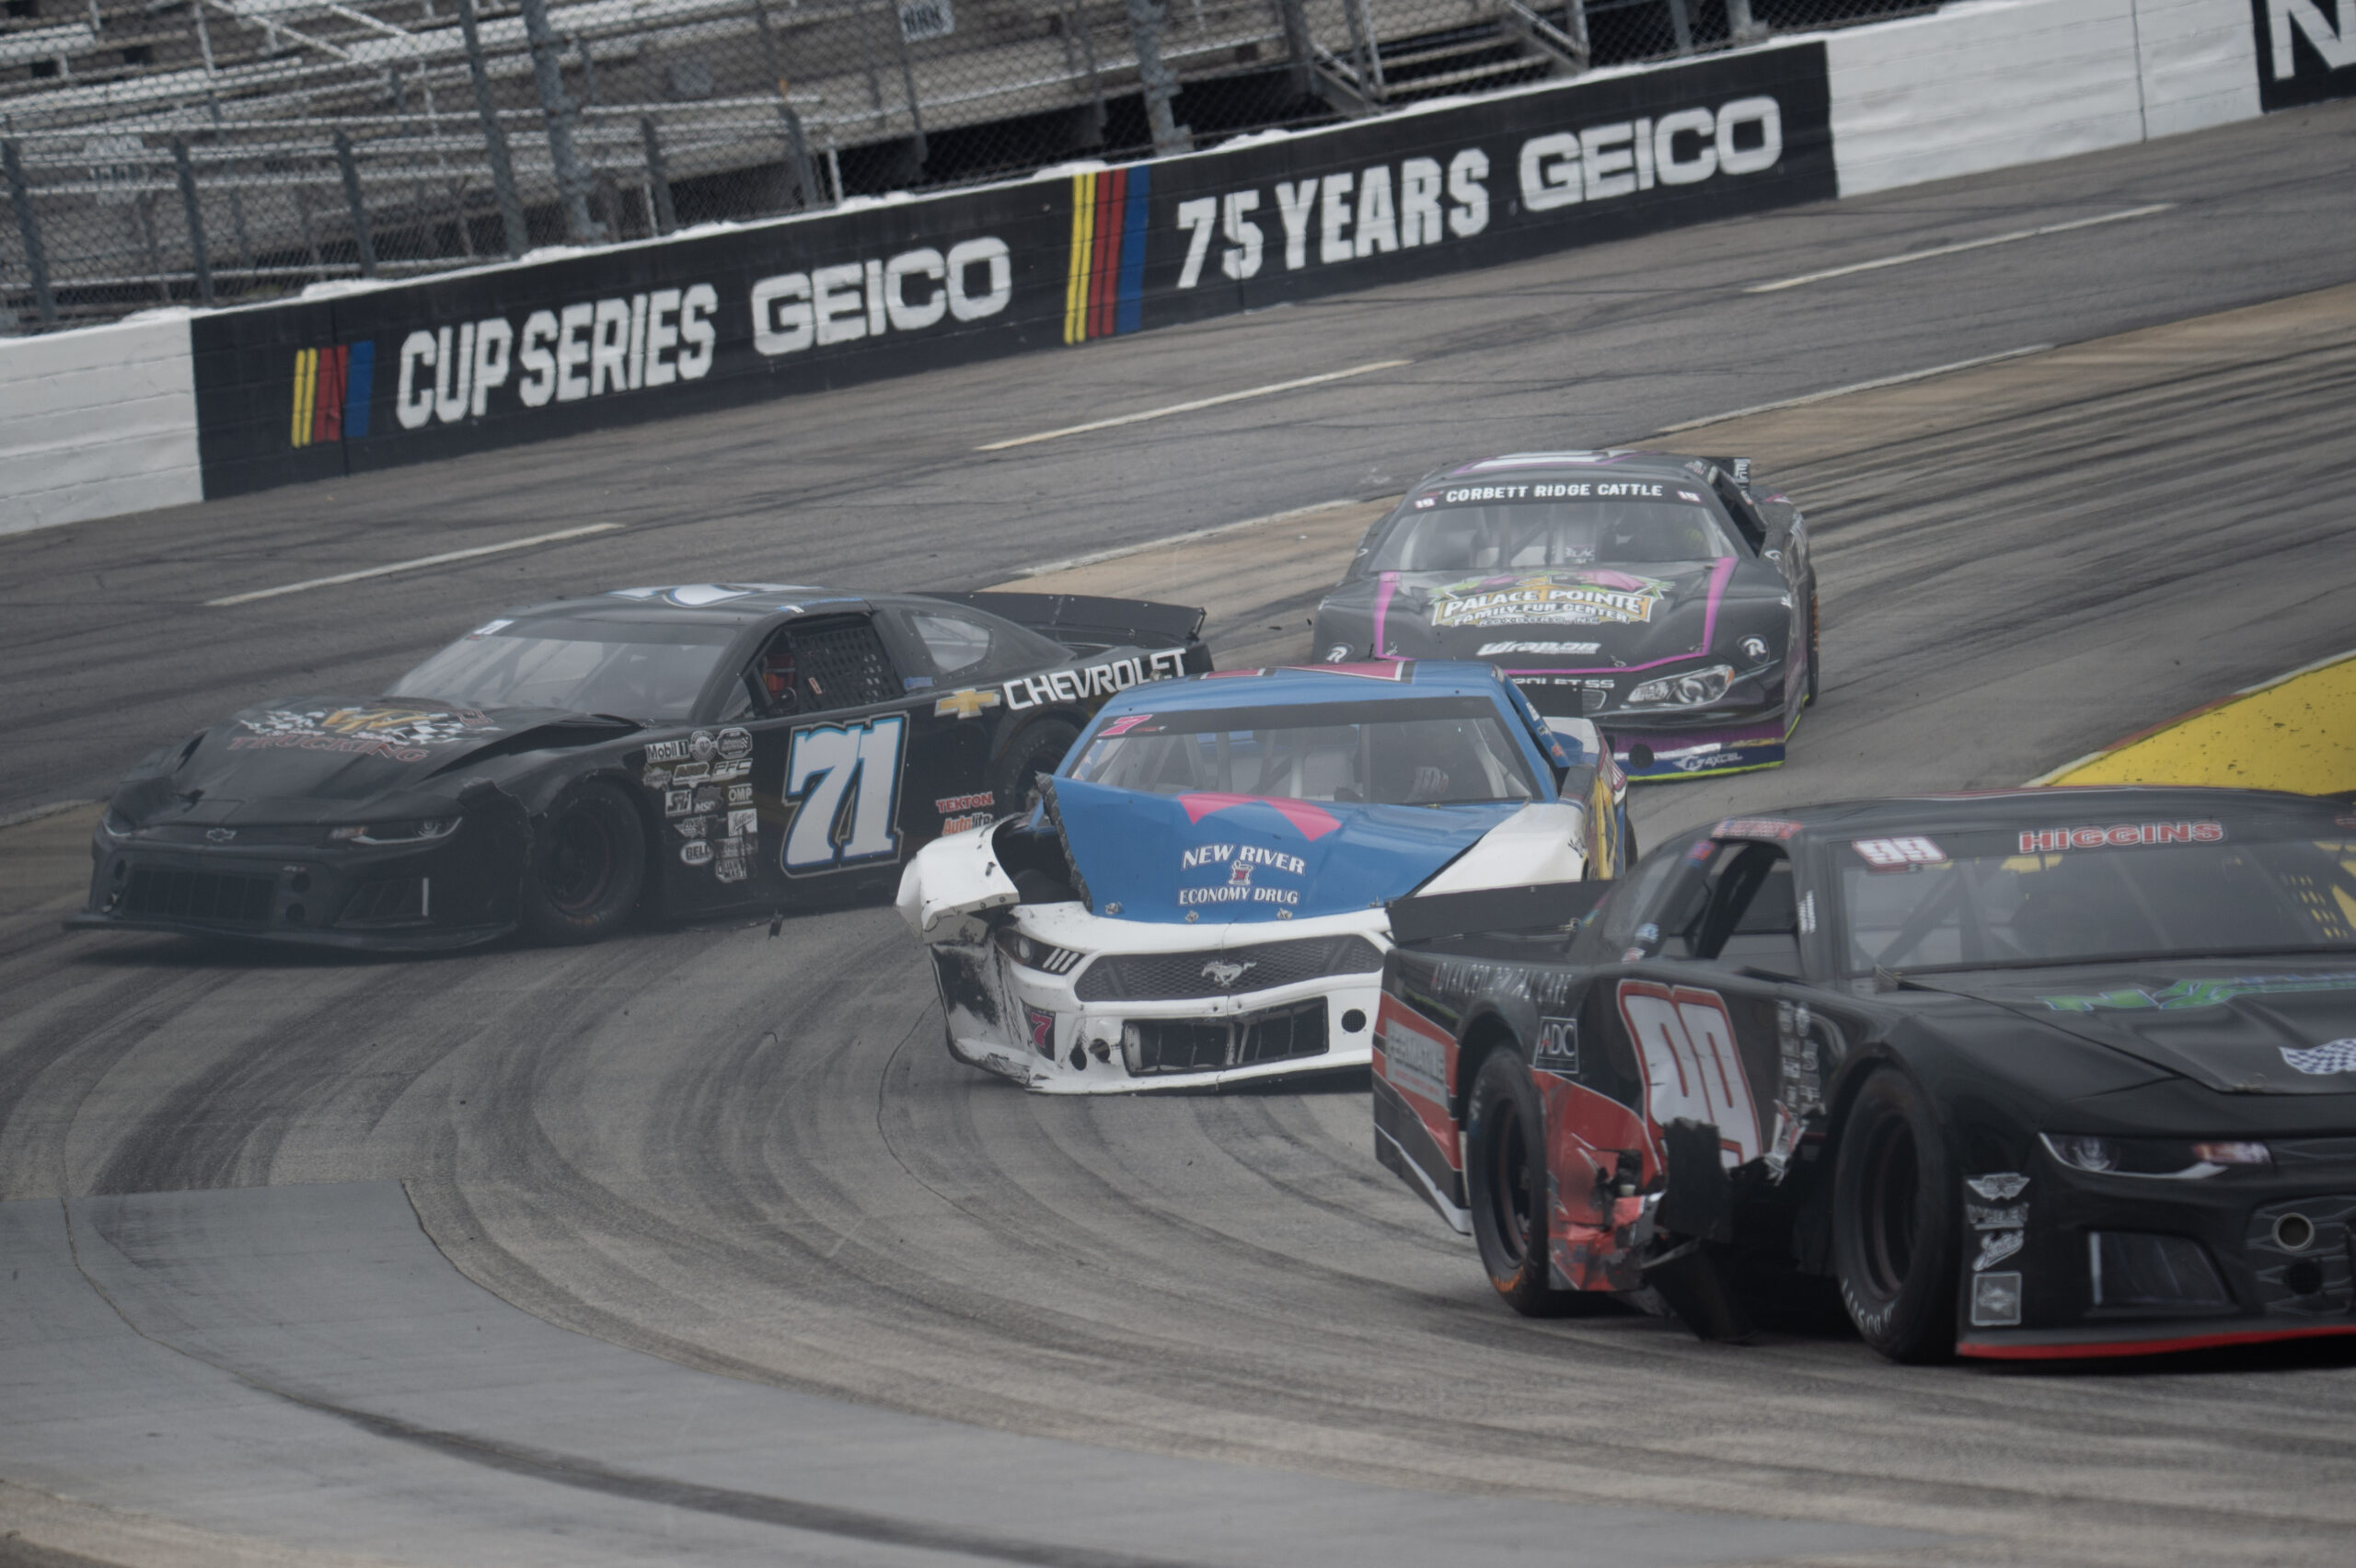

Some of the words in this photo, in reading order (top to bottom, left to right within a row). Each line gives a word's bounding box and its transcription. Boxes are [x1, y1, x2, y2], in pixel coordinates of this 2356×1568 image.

[1519, 95, 1782, 213] GEICO
[1177, 190, 1264, 289] 75
[1276, 148, 1490, 271] YEARS
[751, 236, 1011, 356] GEICO
[397, 317, 514, 430] CUP
[519, 282, 719, 408] SERIES
[1446, 485, 1529, 502] CORBETT
[1534, 483, 1590, 498] RIDGE
[1598, 483, 1662, 497] CATTLE
[1444, 589, 1541, 617] PALACE
[1549, 589, 1644, 614] POINTE
[1523, 603, 1557, 613] FUN
[1567, 604, 1630, 625] CENTER
[1003, 648, 1186, 710] CHEVROLET
[227, 736, 430, 763] TRUCKING
[647, 743, 677, 760] Mobil
[728, 787, 753, 801] OMP
[783, 714, 907, 870] 71
[936, 791, 995, 814] TEKTON
[2019, 821, 2224, 854] HIGGINS
[1183, 844, 1234, 870] NEW
[1240, 845, 1305, 874] RIVER
[1179, 886, 1251, 905] ECONOMY
[1253, 888, 1299, 905] DRUG
[1031, 1011, 1052, 1048] 7
[1539, 1023, 1576, 1057] ADC
